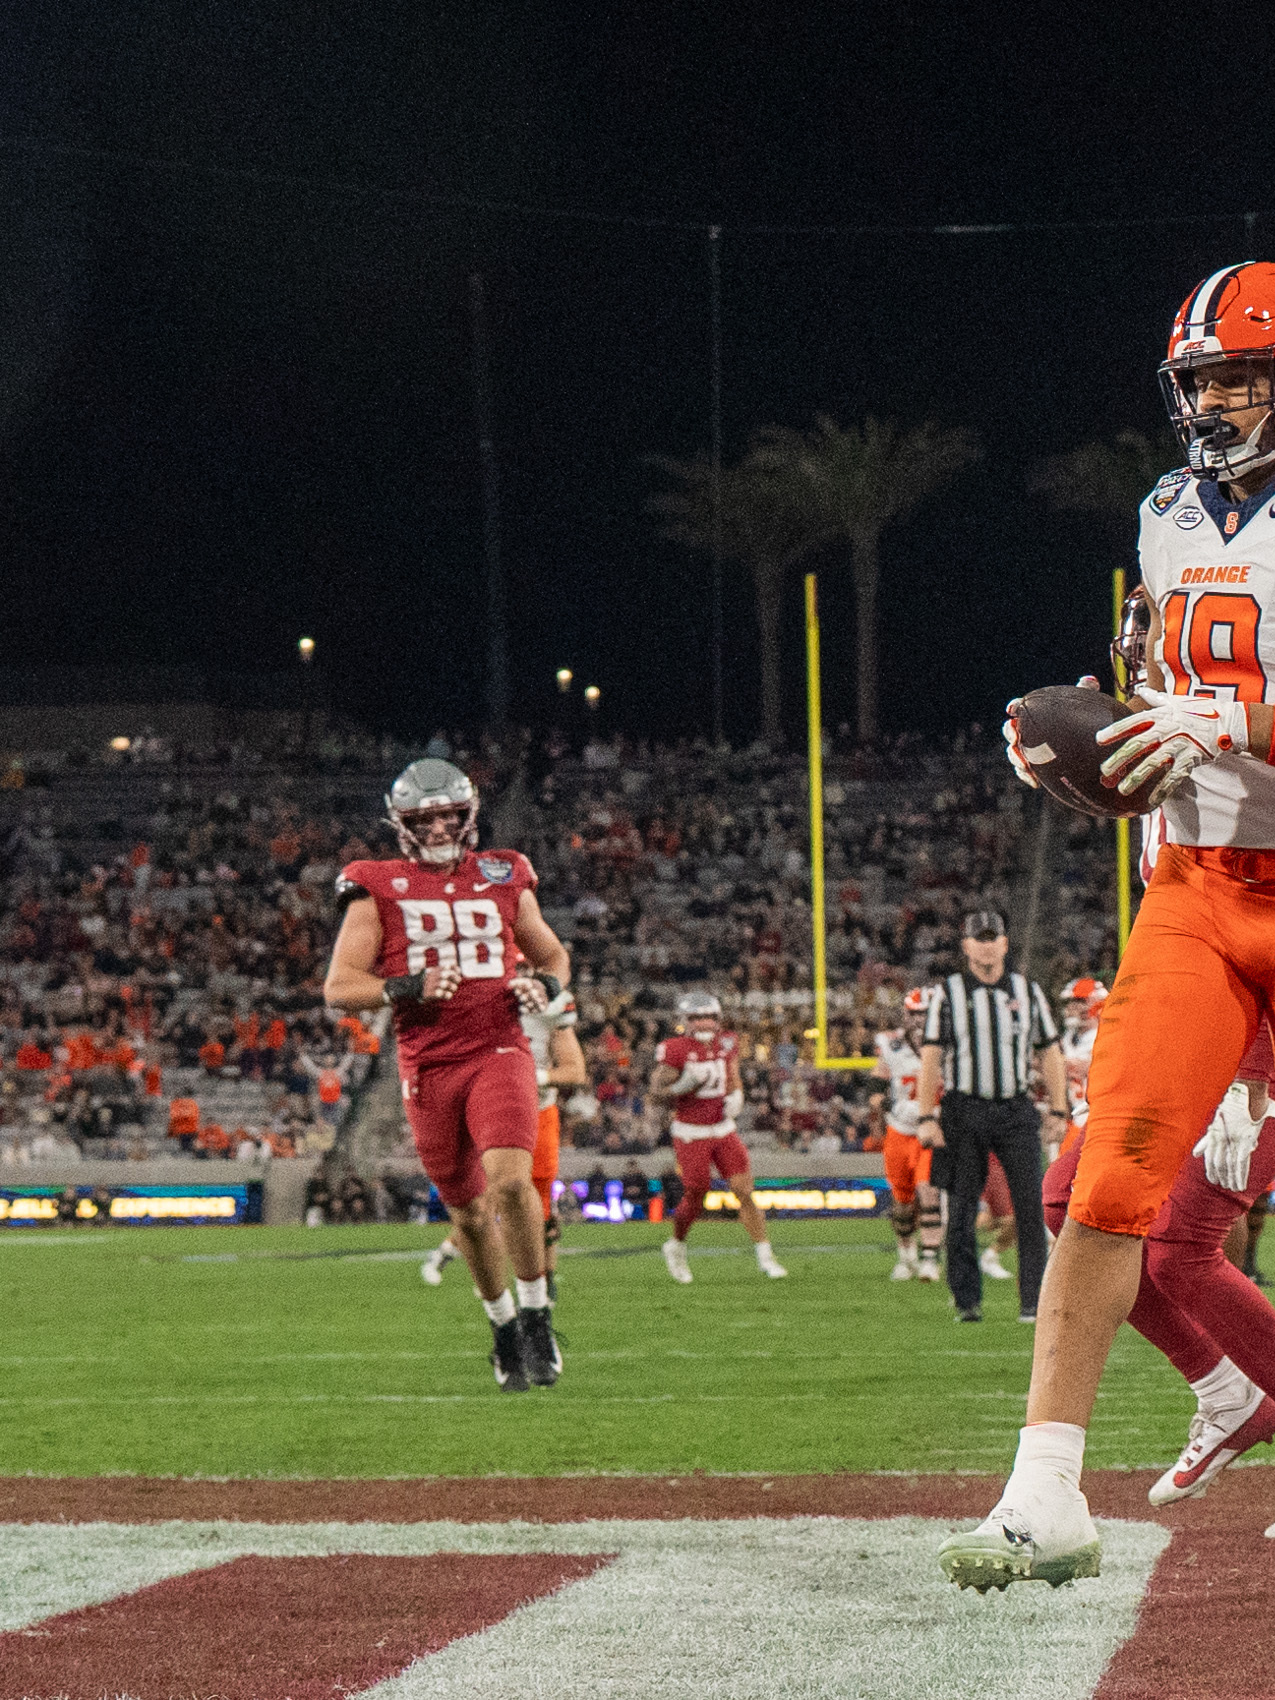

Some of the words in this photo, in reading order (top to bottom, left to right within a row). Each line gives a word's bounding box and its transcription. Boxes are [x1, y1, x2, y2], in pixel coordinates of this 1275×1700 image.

[1177, 511, 1200, 520] ACC
[1180, 565, 1251, 584] ORANGE
[1163, 591, 1268, 704] 19
[397, 899, 505, 979] 88
